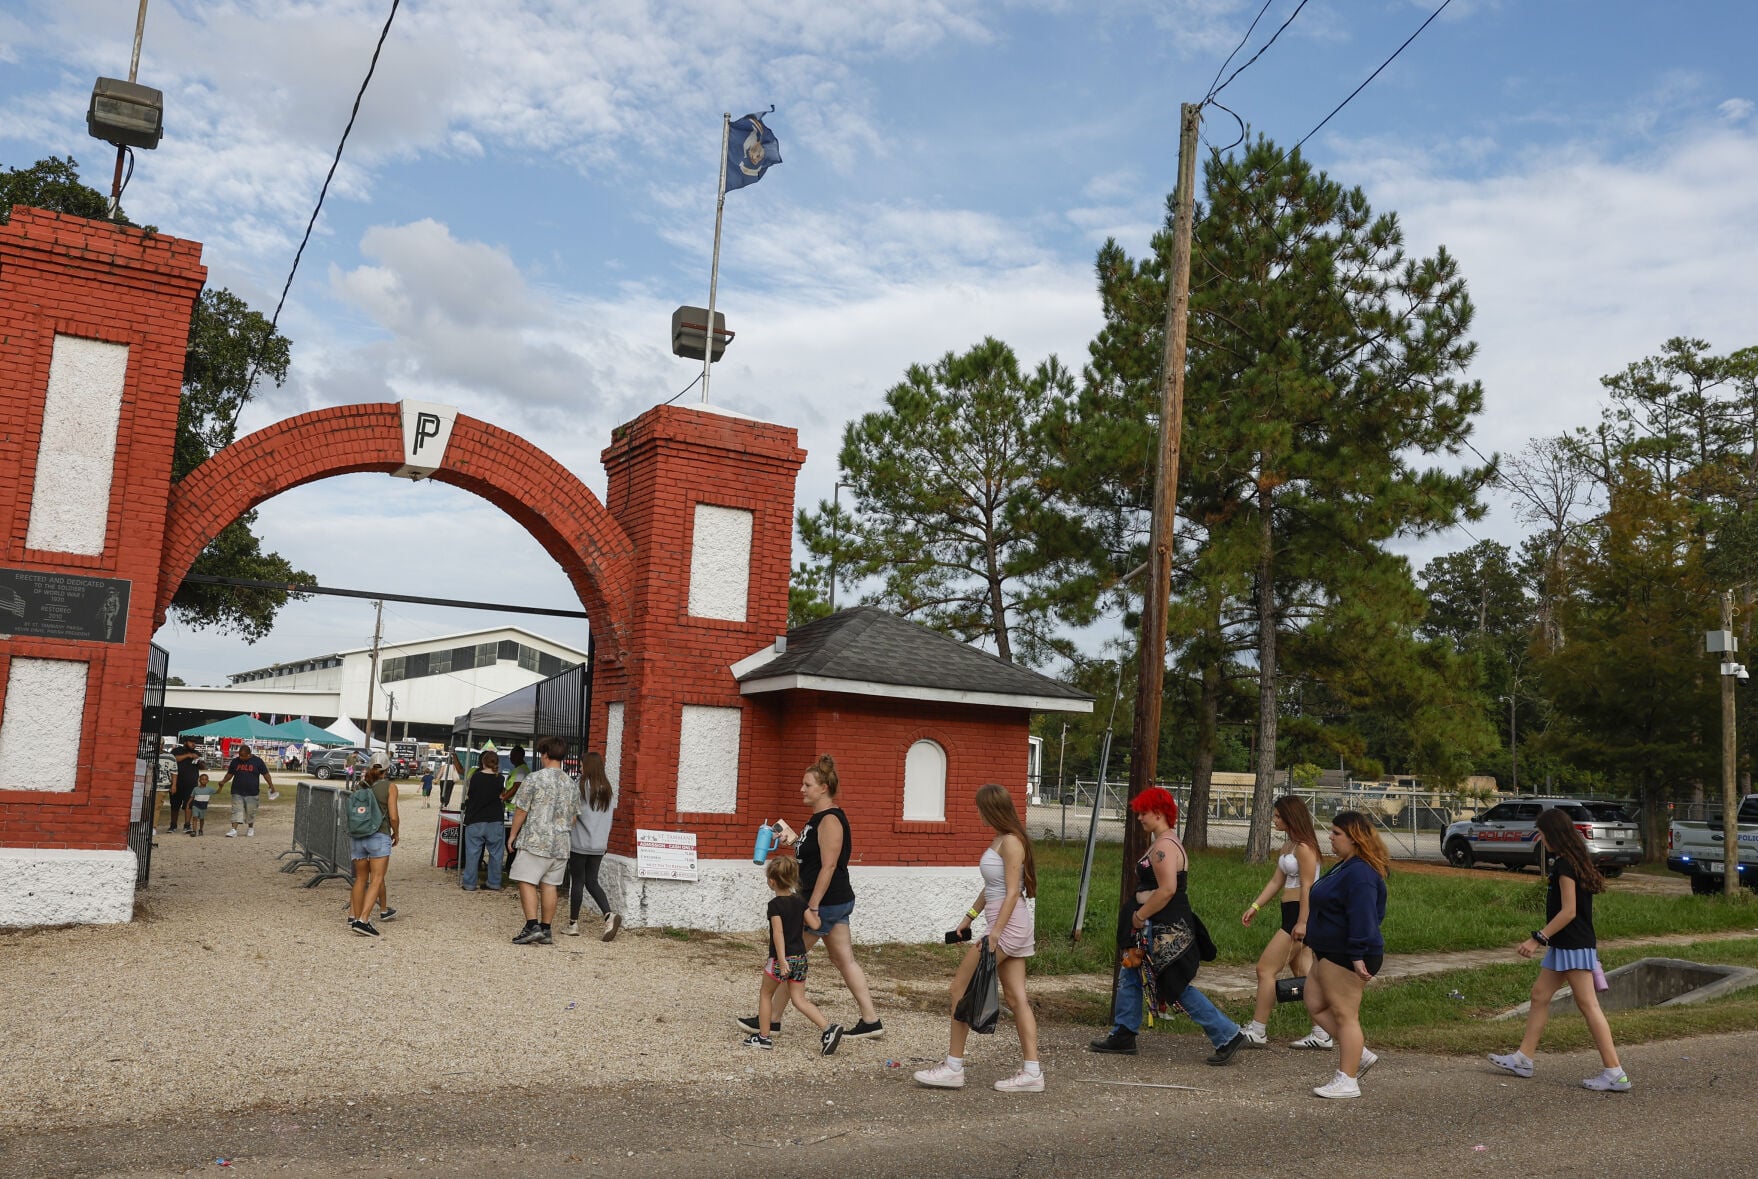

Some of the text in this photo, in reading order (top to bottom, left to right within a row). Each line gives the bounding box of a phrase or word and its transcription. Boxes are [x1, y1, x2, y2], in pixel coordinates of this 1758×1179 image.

[15, 574, 47, 583] ERECTED
[66, 578, 105, 588] DEDICATED
[44, 589, 65, 597] WORLD
[57, 585, 86, 593] SOLDIERS
[40, 606, 72, 614] RESTORED
[1478, 831, 1523, 843] POLICE
